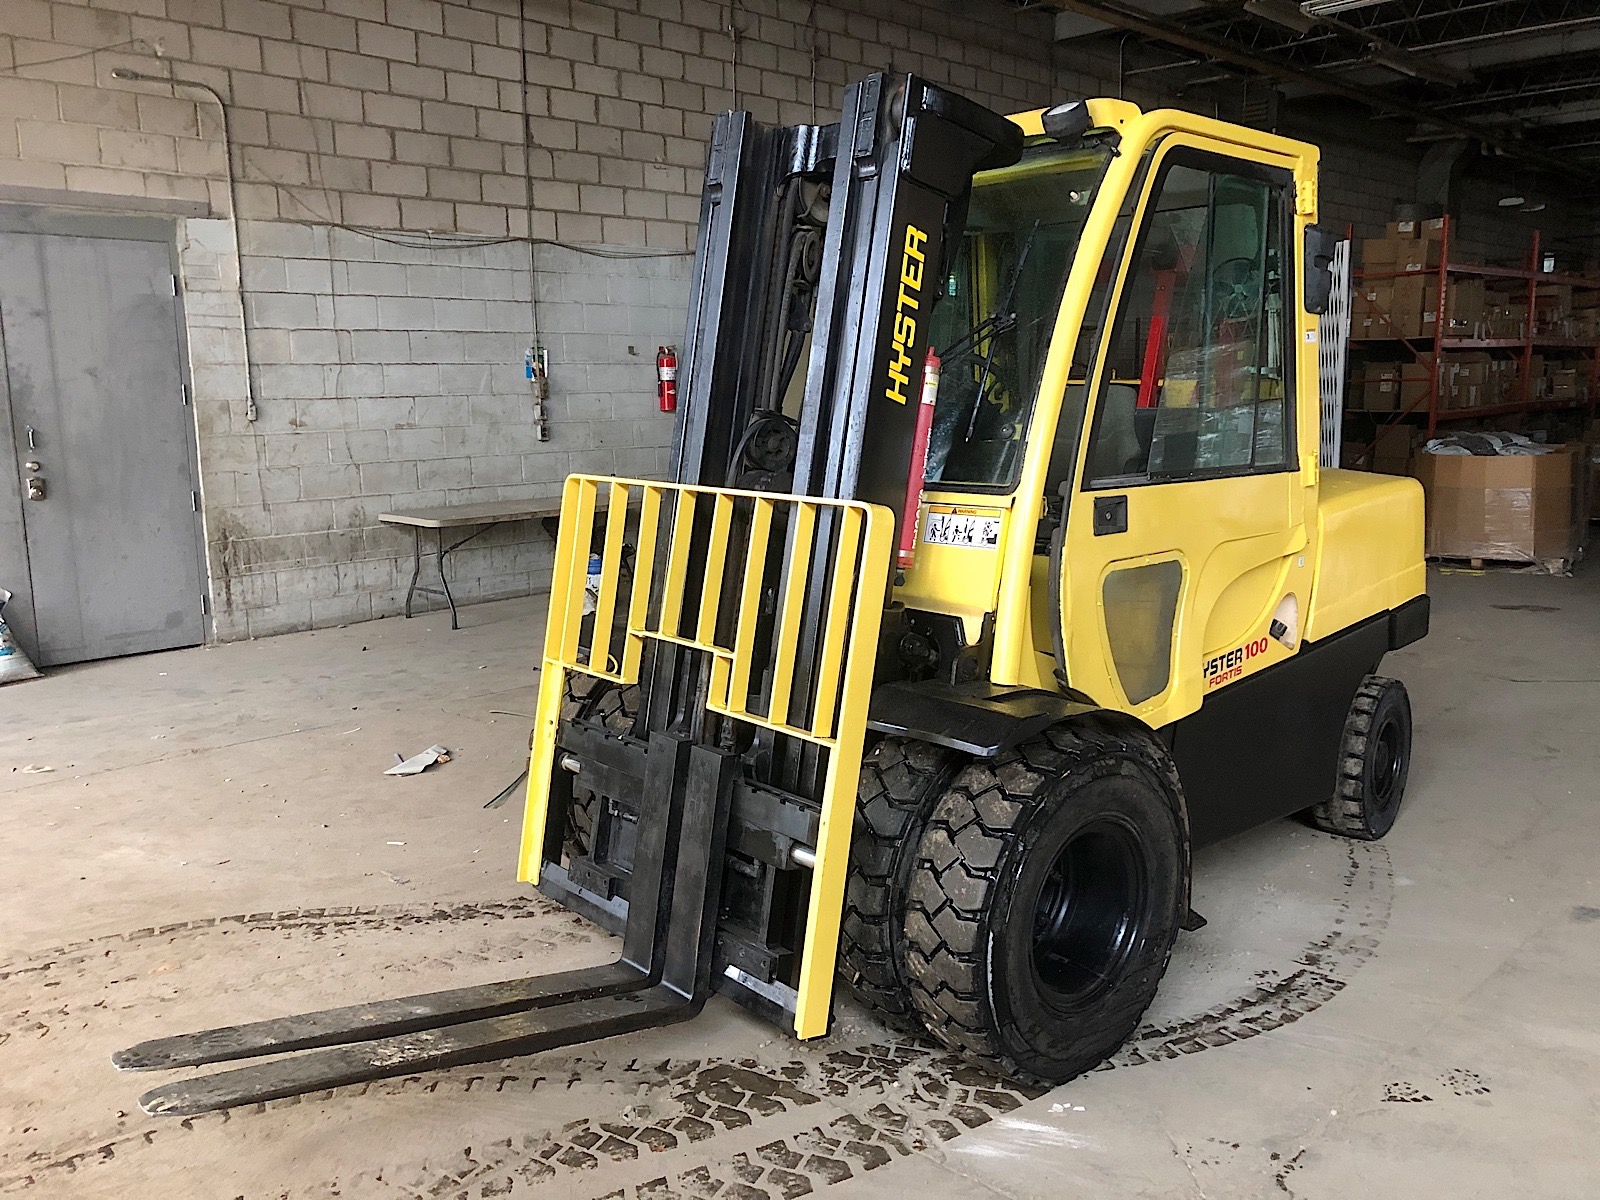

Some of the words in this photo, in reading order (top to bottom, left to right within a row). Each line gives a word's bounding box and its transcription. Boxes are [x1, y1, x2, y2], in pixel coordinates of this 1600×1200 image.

[885, 224, 928, 406] HYSTER
[1202, 647, 1243, 679] YSTER
[1245, 637, 1268, 659] 100
[1208, 665, 1243, 688] FORTIS
